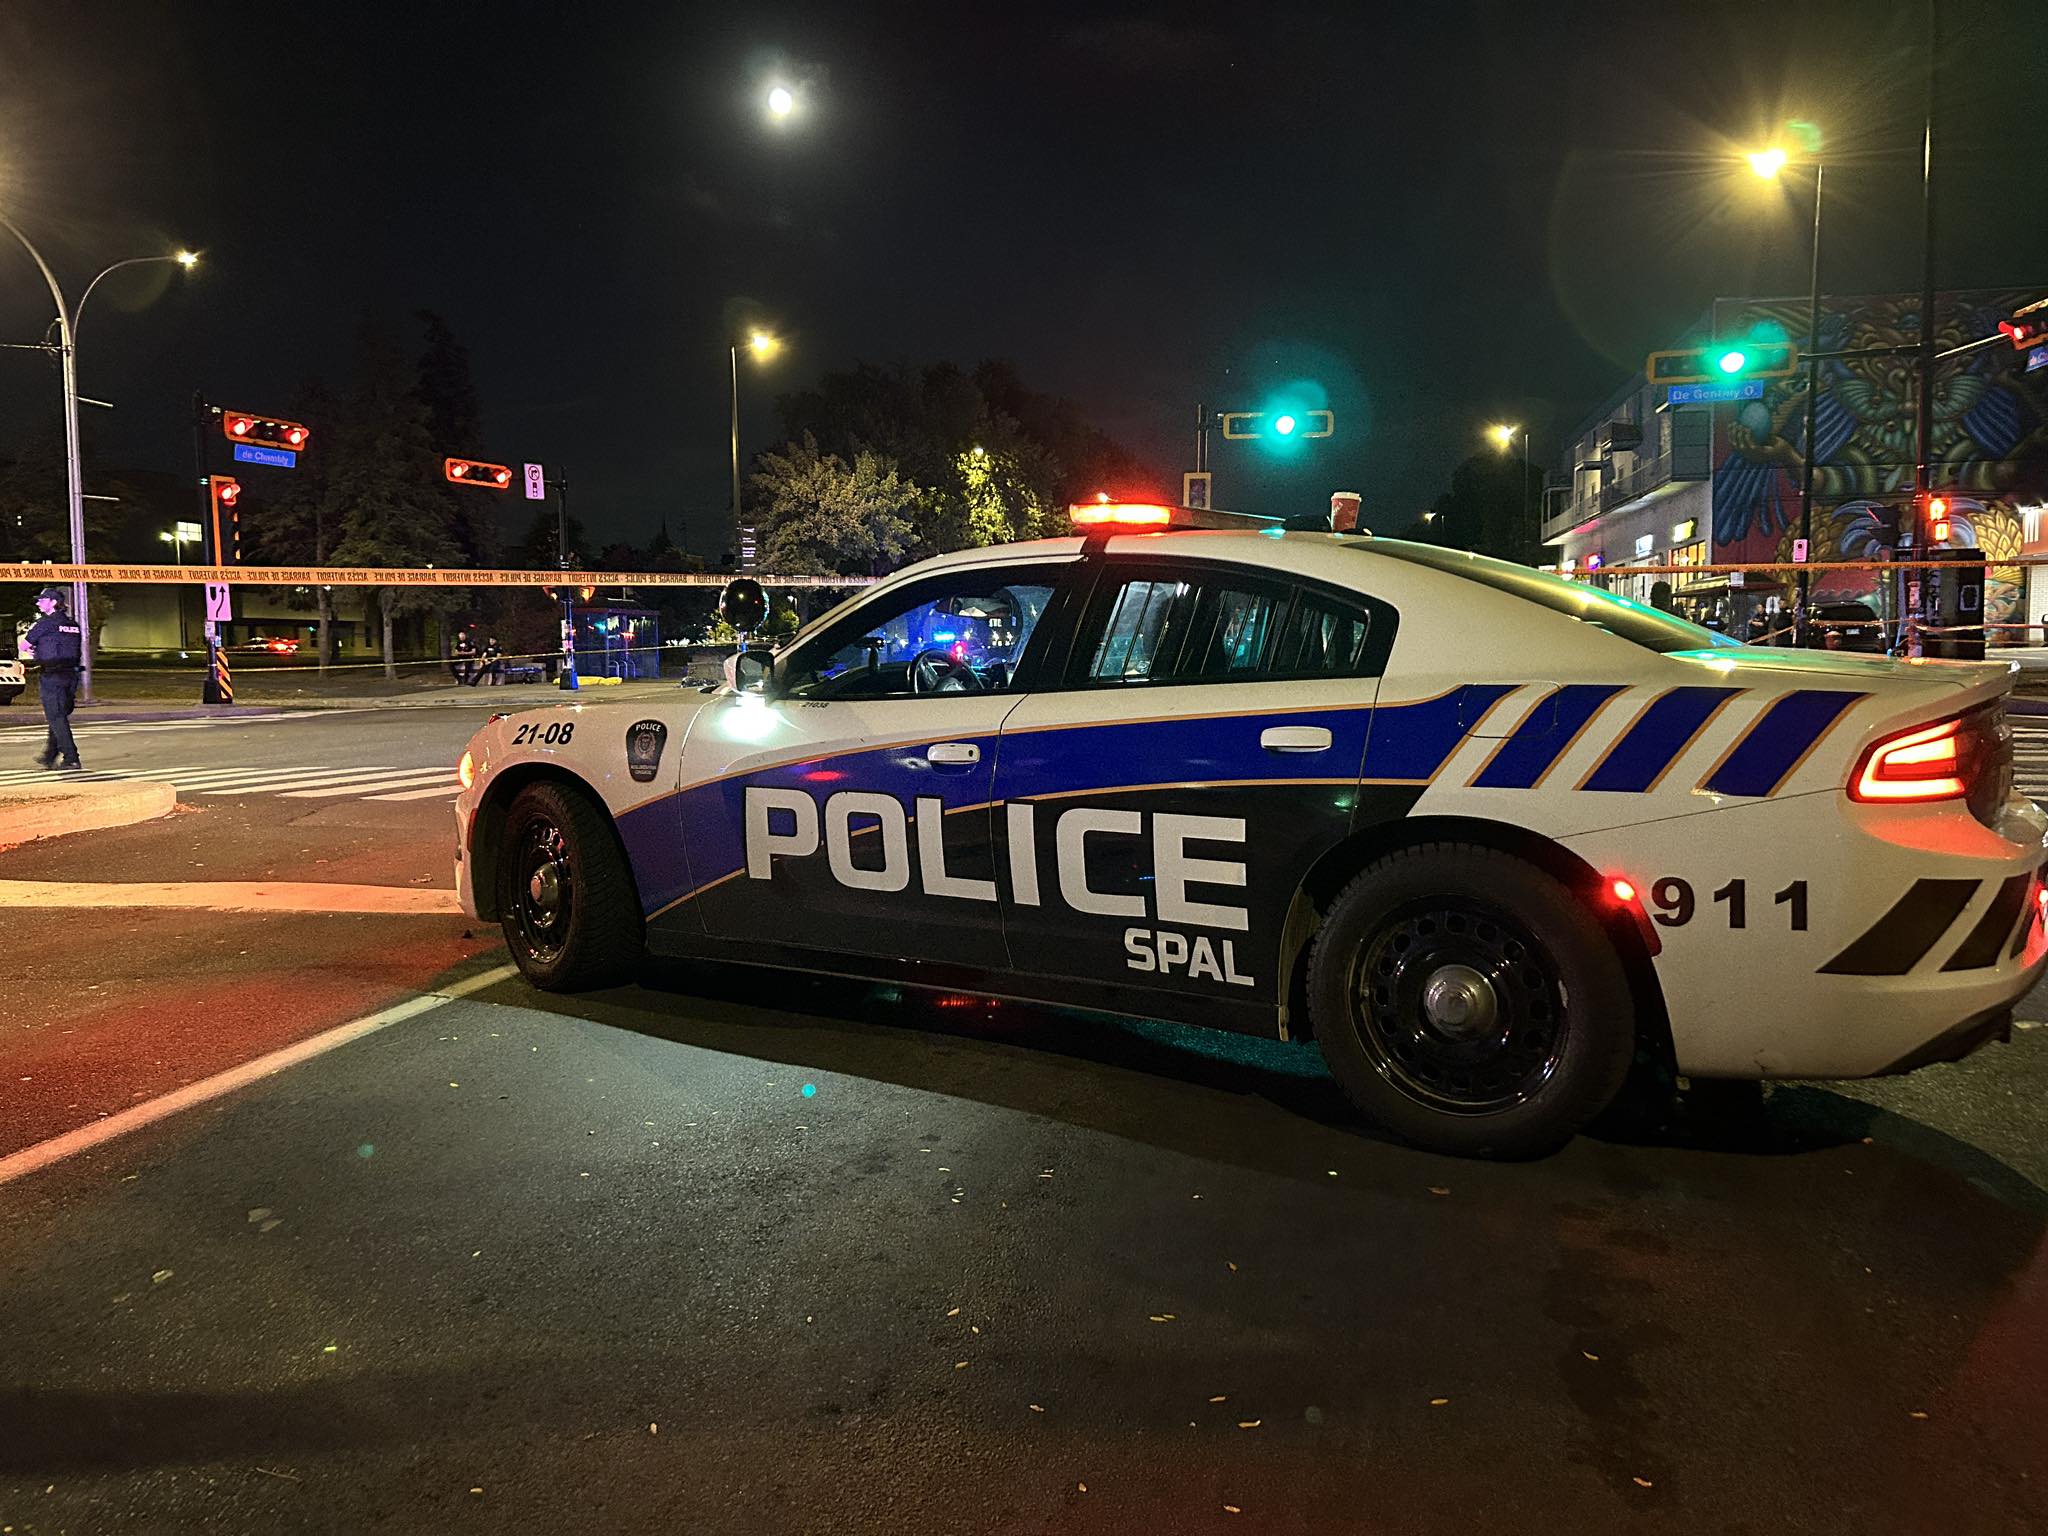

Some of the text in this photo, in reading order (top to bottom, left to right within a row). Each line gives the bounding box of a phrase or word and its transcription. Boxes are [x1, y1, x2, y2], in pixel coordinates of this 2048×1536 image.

[1673, 391, 1689, 400] De
[242, 451, 289, 465] de Chambly
[512, 722, 575, 746] 21-08
[635, 722, 662, 733] POLICE
[745, 786, 1249, 931] POLICE
[1651, 877, 1808, 931] 911
[1124, 927, 1255, 987] SPAL
